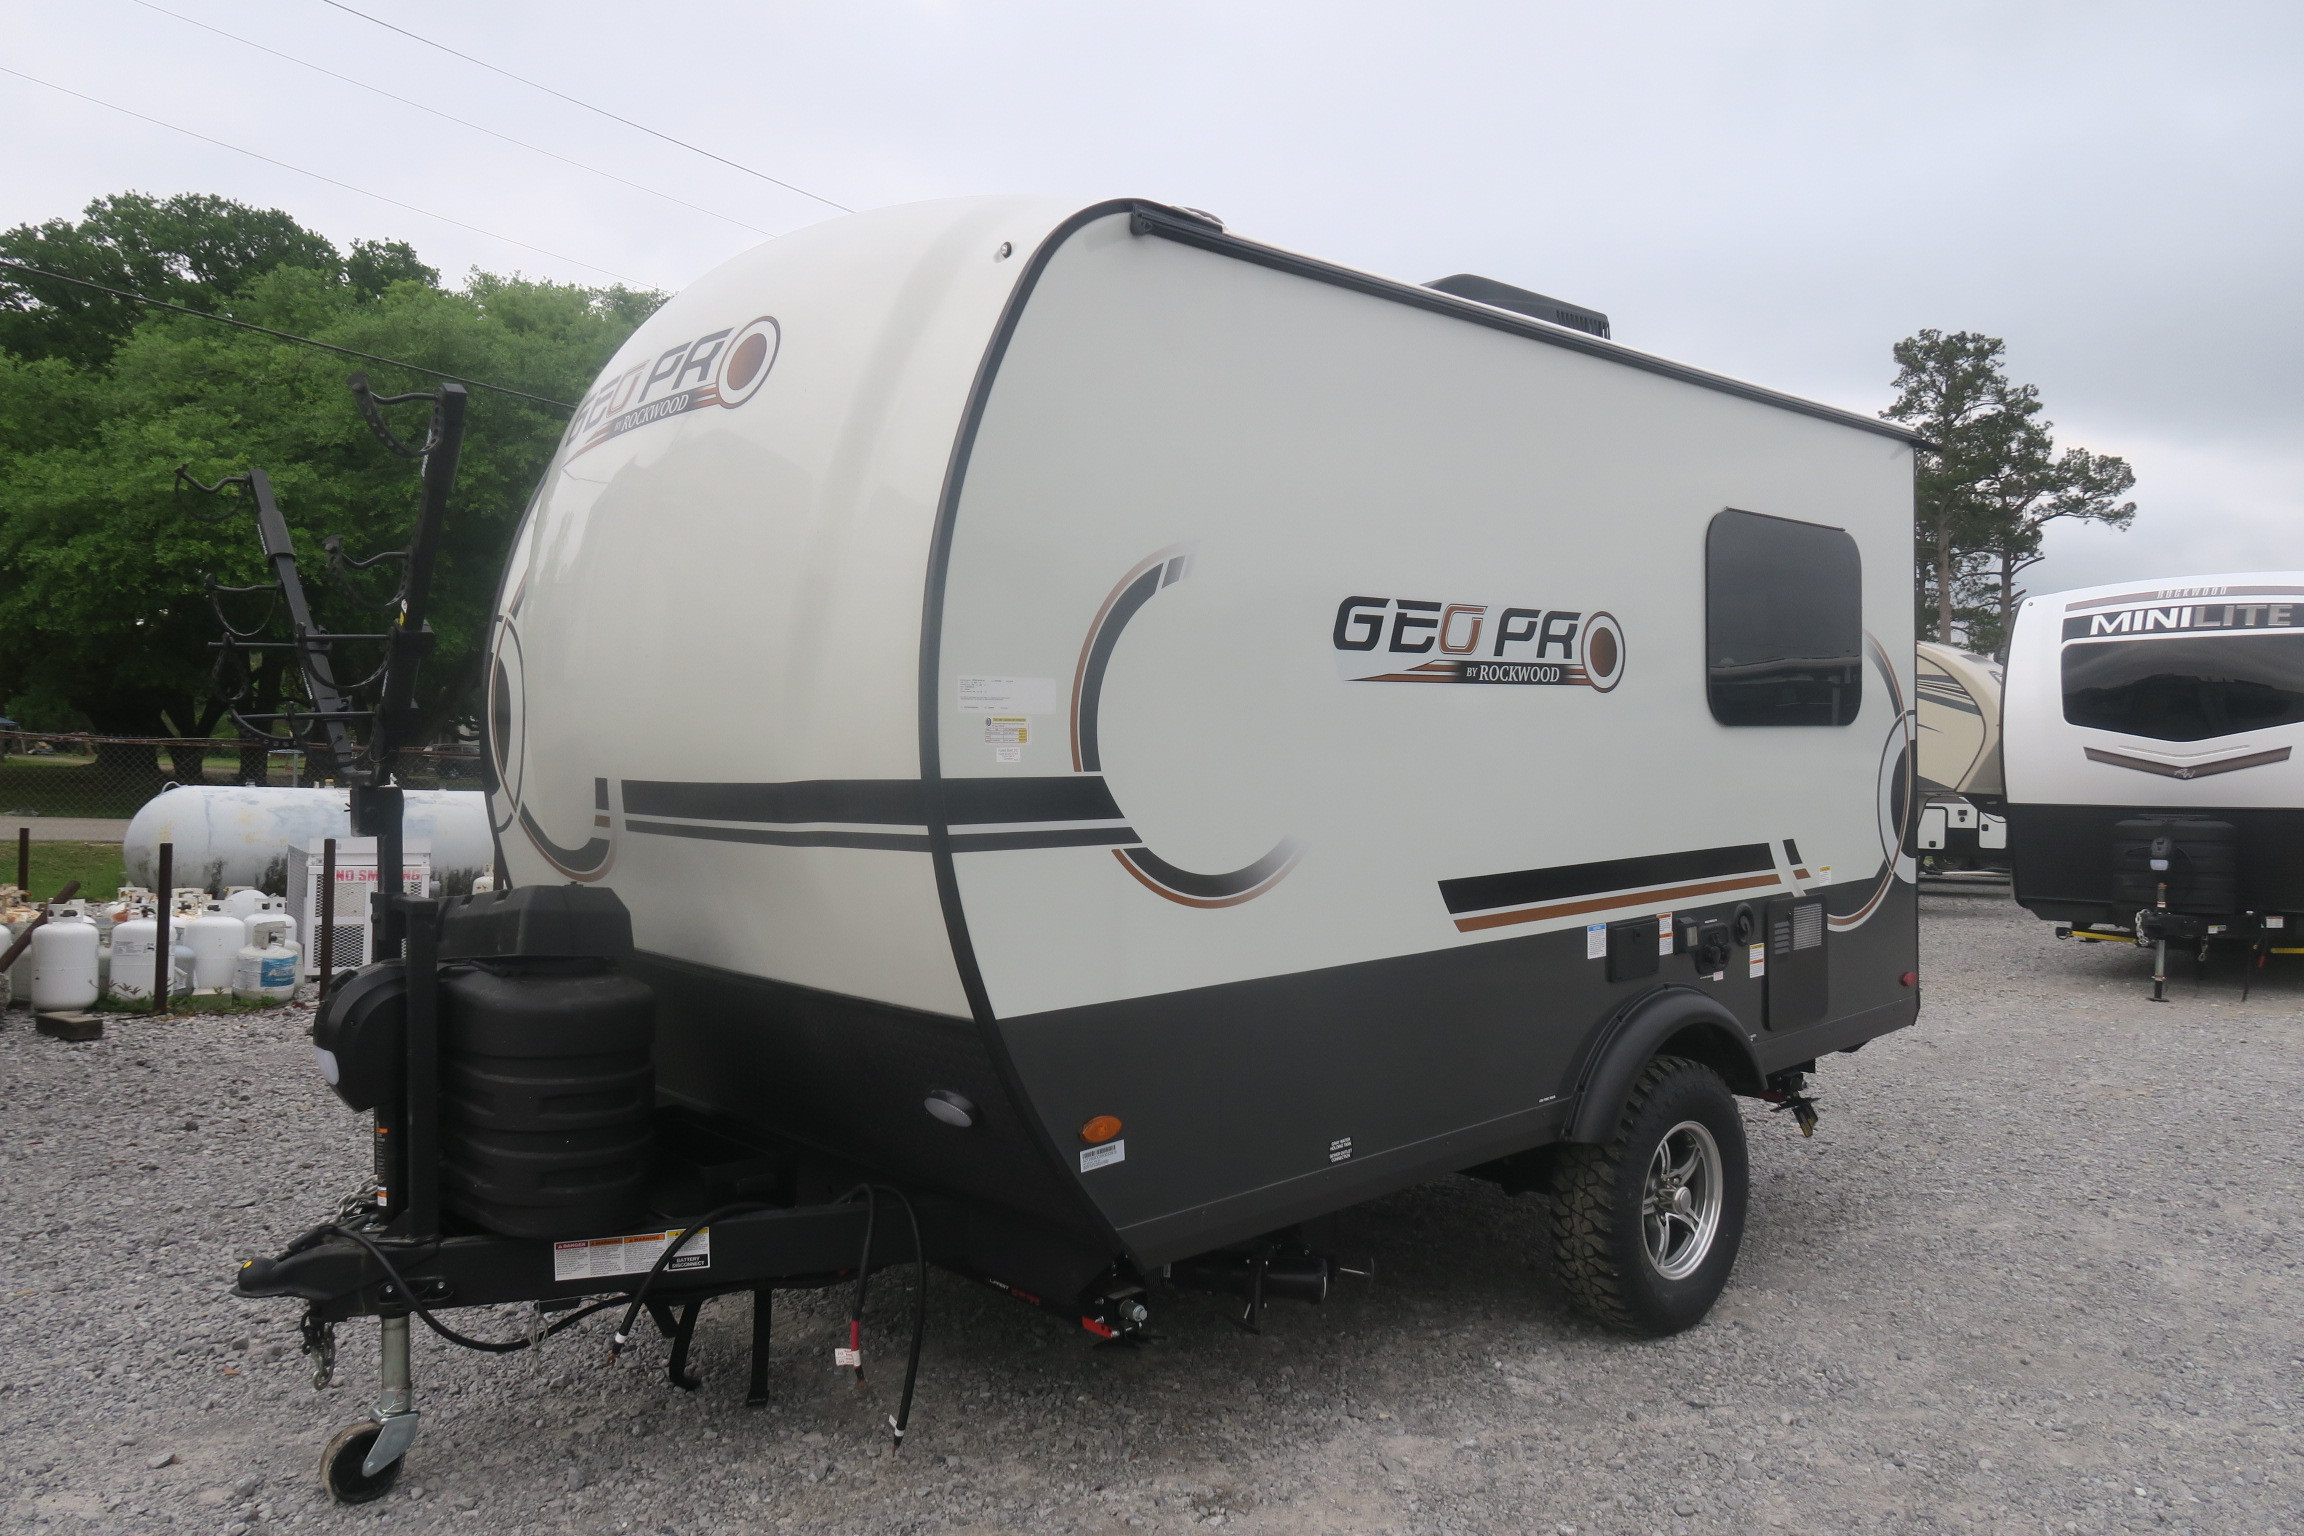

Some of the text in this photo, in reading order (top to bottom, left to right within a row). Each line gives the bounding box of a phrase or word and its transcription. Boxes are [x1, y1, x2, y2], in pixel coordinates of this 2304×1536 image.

[637, 315, 781, 409] PRO
[621, 394, 689, 431] ROCKWOOD
[2090, 605, 2292, 635] MINILITE
[1332, 595, 1626, 693] GEO PRO
[1466, 664, 1560, 682] BY ROCKWOOD
[336, 869, 420, 882] NO SMNG
[671, 1260, 705, 1269] DISCONNECT
